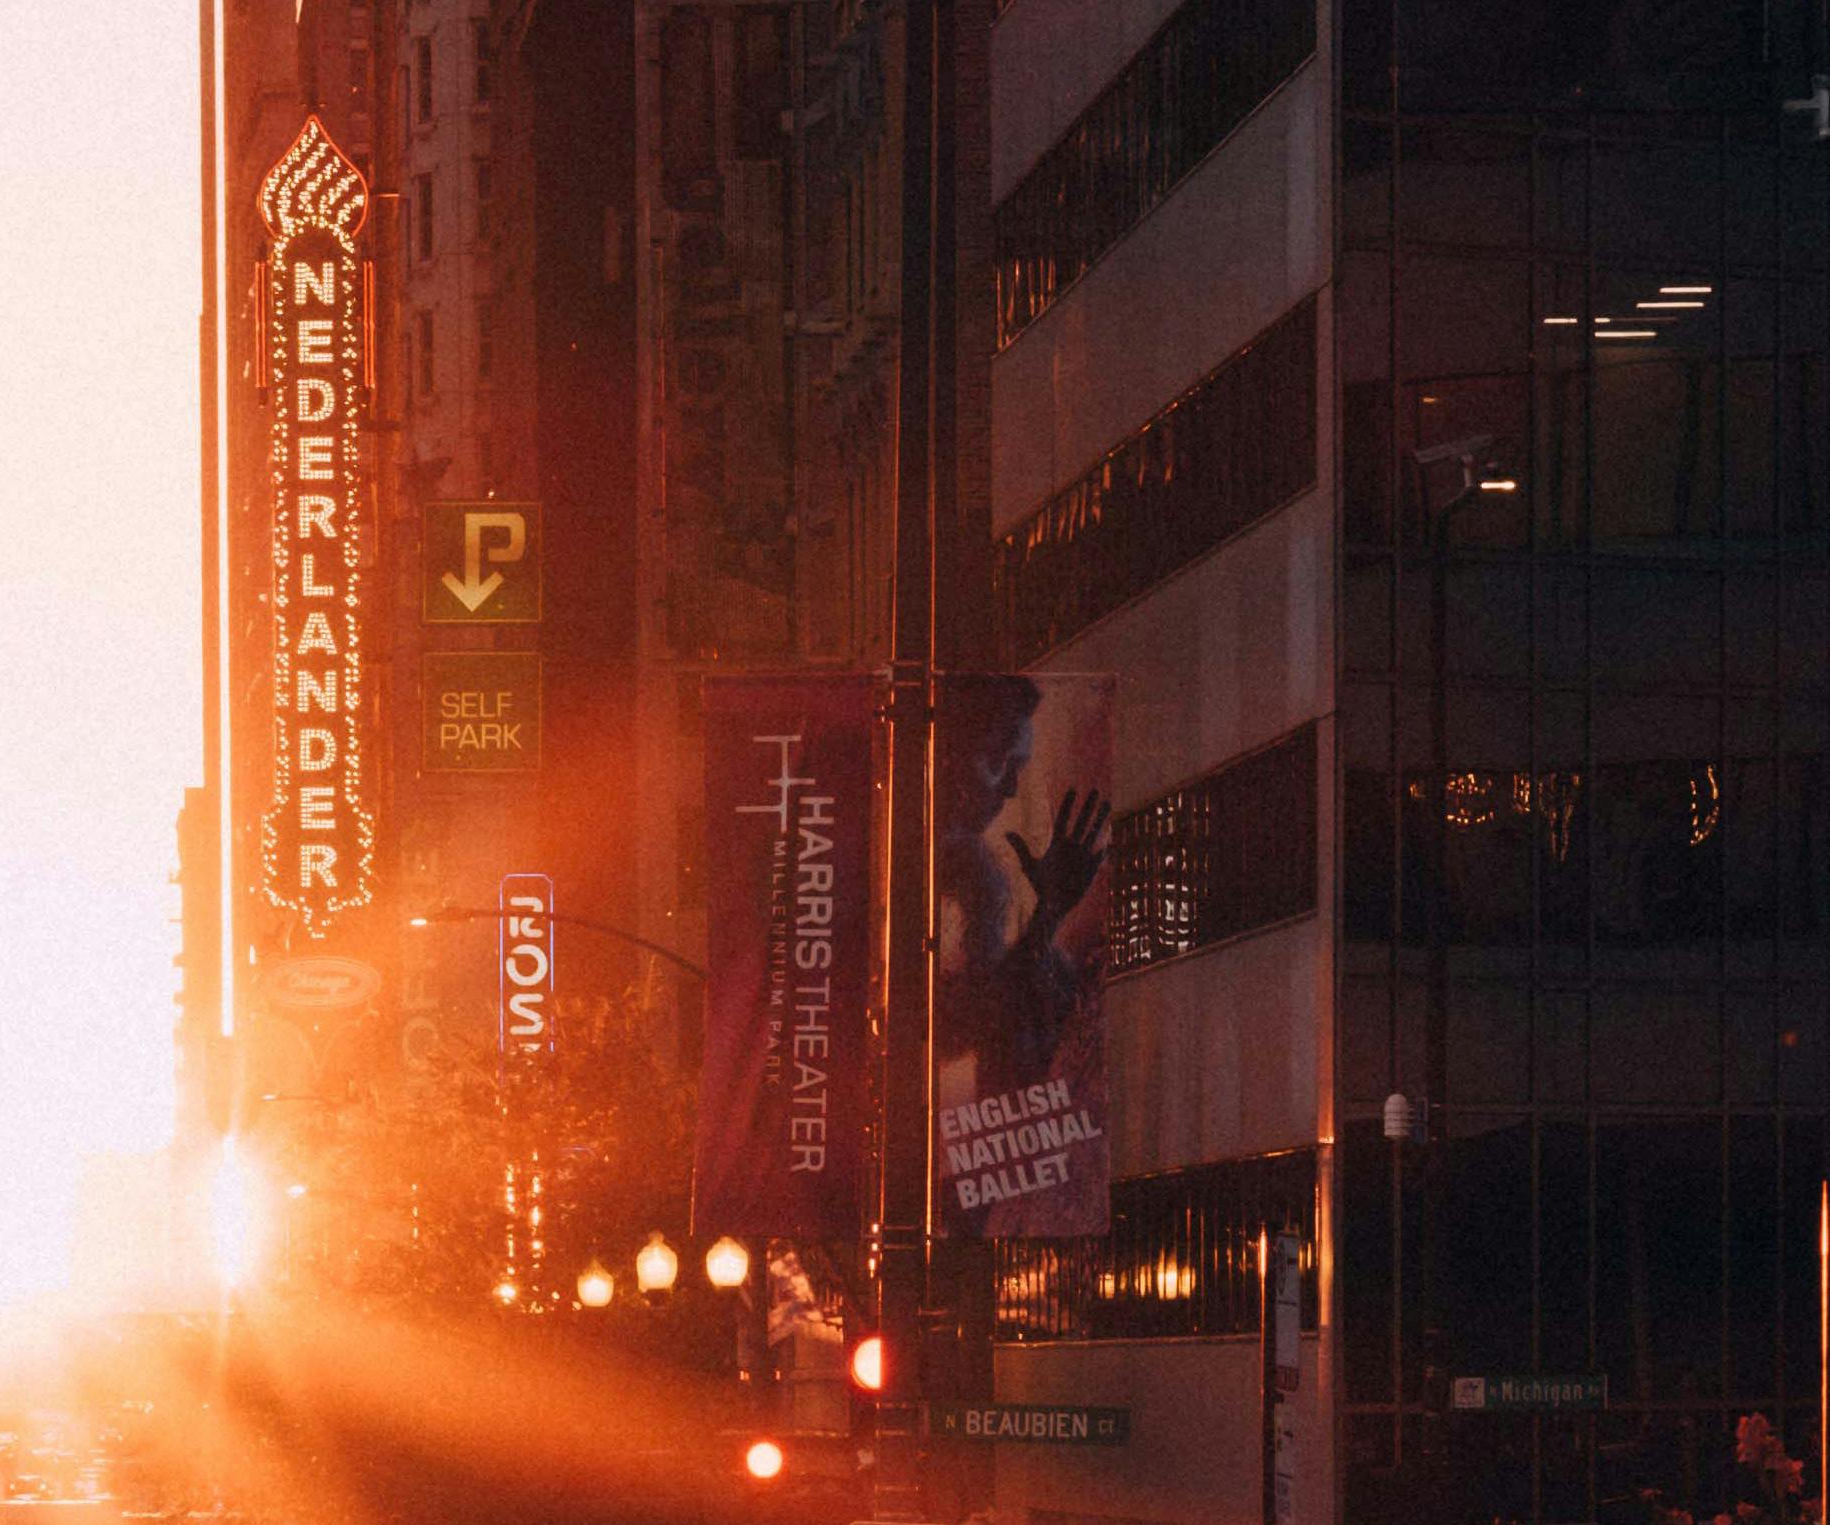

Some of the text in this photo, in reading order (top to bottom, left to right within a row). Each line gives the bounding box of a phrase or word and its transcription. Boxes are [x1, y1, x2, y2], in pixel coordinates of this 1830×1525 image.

[294, 262, 338, 889] NEDERLANDER
[441, 692, 514, 718] SELF
[440, 723, 522, 750] PARK
[505, 895, 549, 1052] ROS
[765, 840, 787, 1088] MILLENNIUM PARK
[790, 795, 836, 1173] HARRIS THEATER
[939, 1077, 1071, 1139] ENGLISH
[946, 1110, 1103, 1175] NATIONAL
[955, 1152, 1070, 1210] BALLET
[1501, 1378, 1584, 1408] Michigan
[945, 1414, 957, 1429] N
[965, 1409, 1089, 1440] BEAUBIEN
